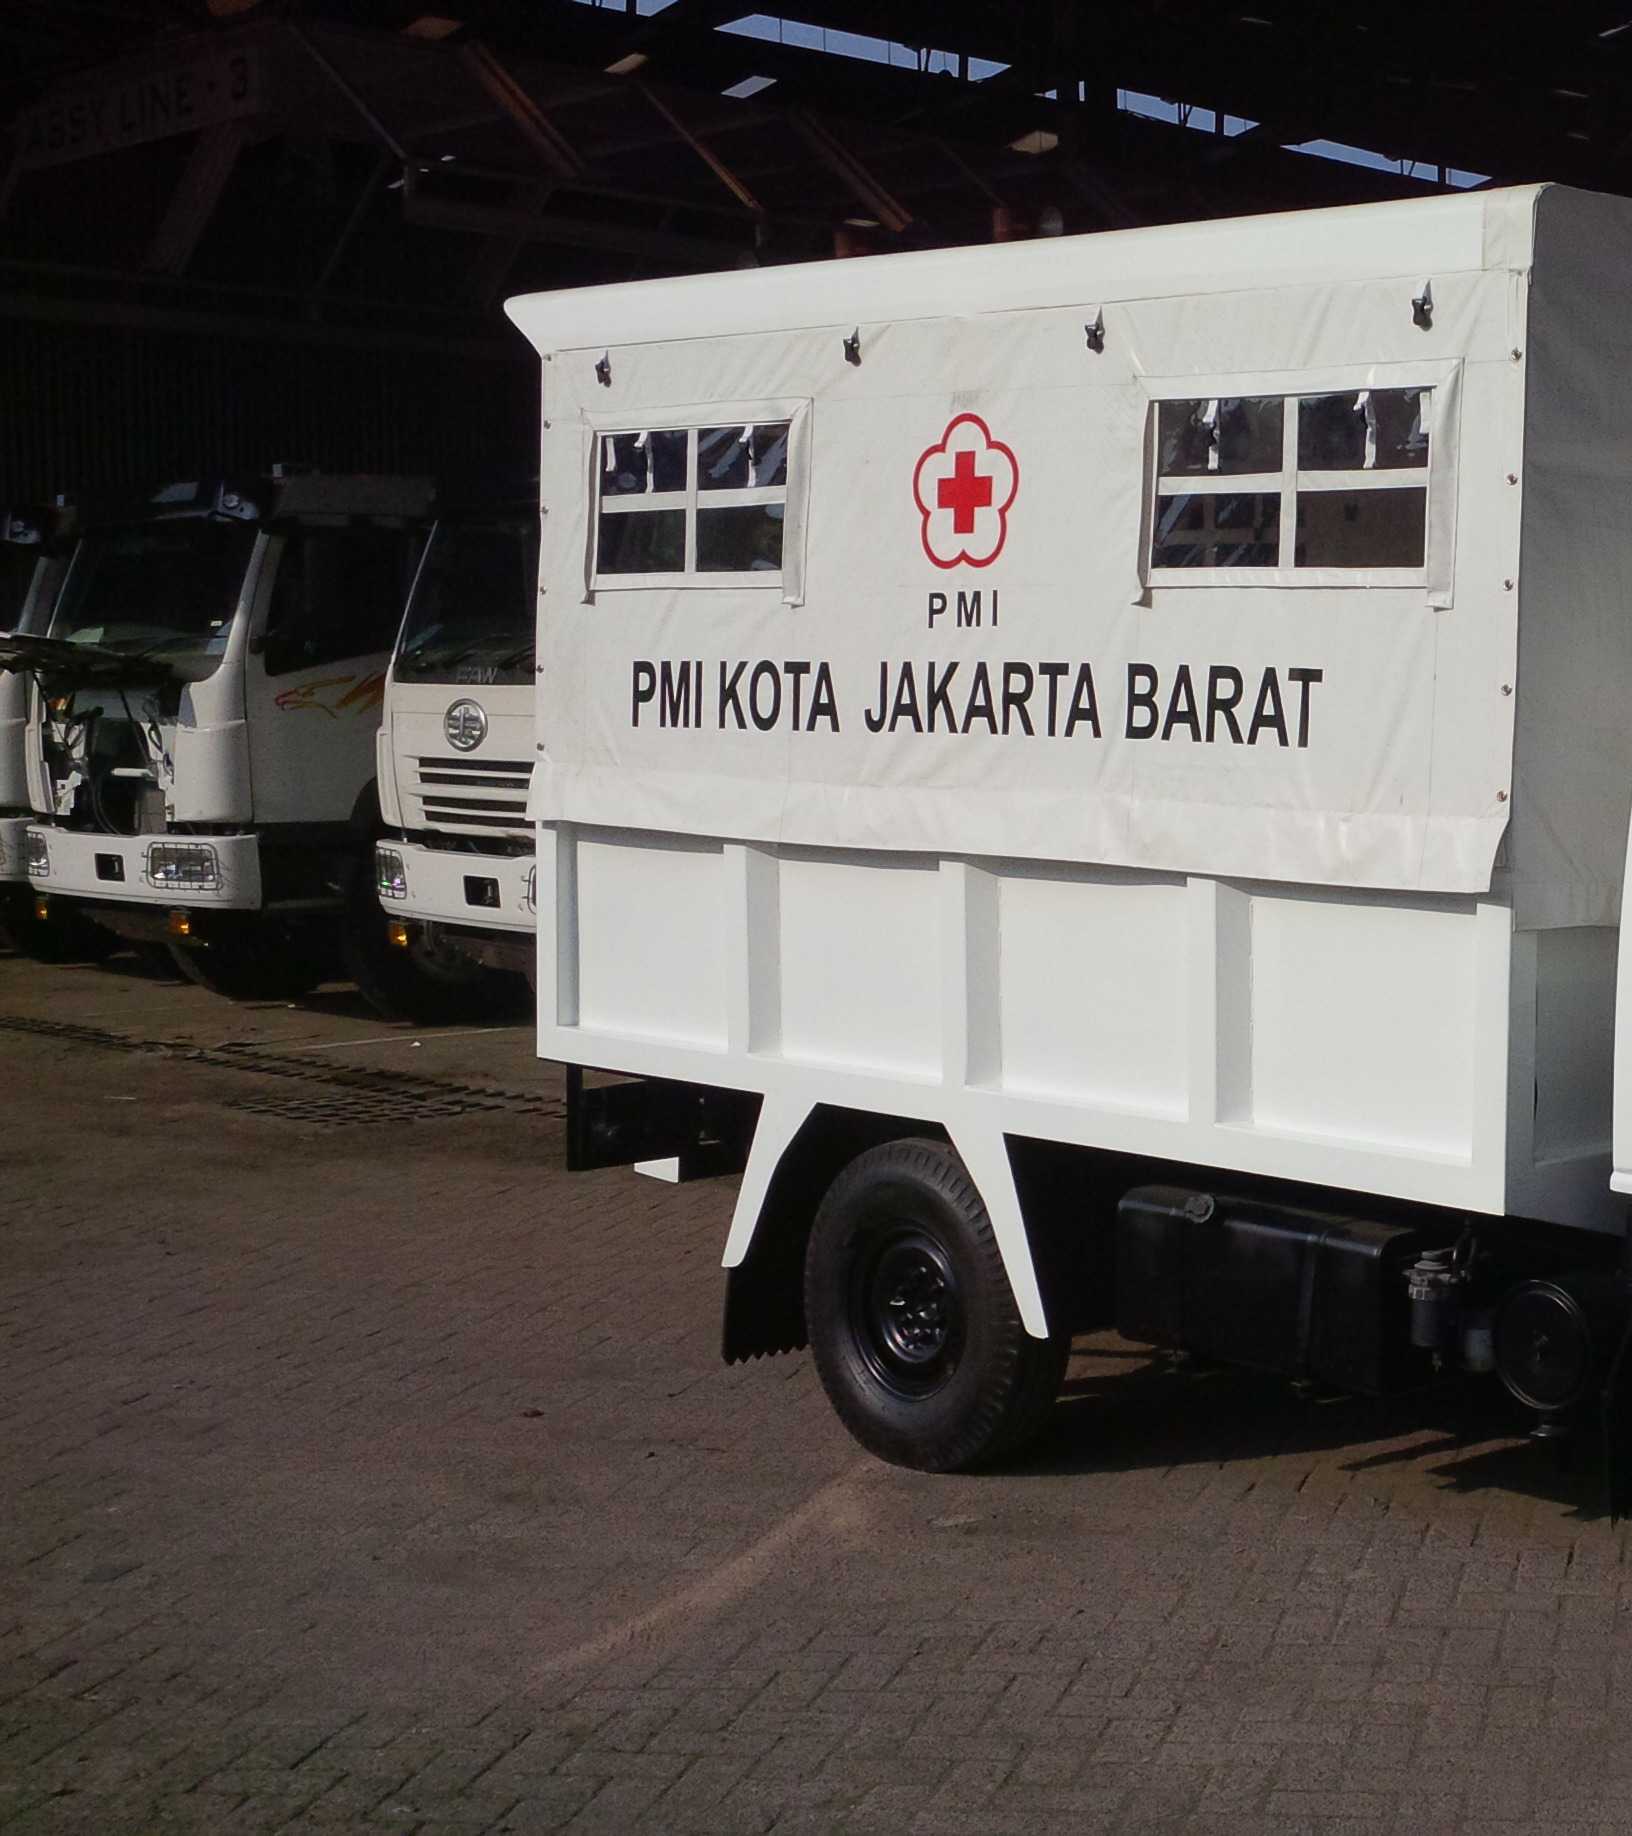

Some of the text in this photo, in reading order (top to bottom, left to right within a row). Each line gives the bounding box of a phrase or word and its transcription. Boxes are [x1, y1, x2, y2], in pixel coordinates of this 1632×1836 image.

[121, 75, 194, 132] LINE
[229, 56, 248, 101] 3
[927, 589, 999, 629] PMI
[631, 660, 1323, 748] PMI KOTA JAKARTA BARAT
